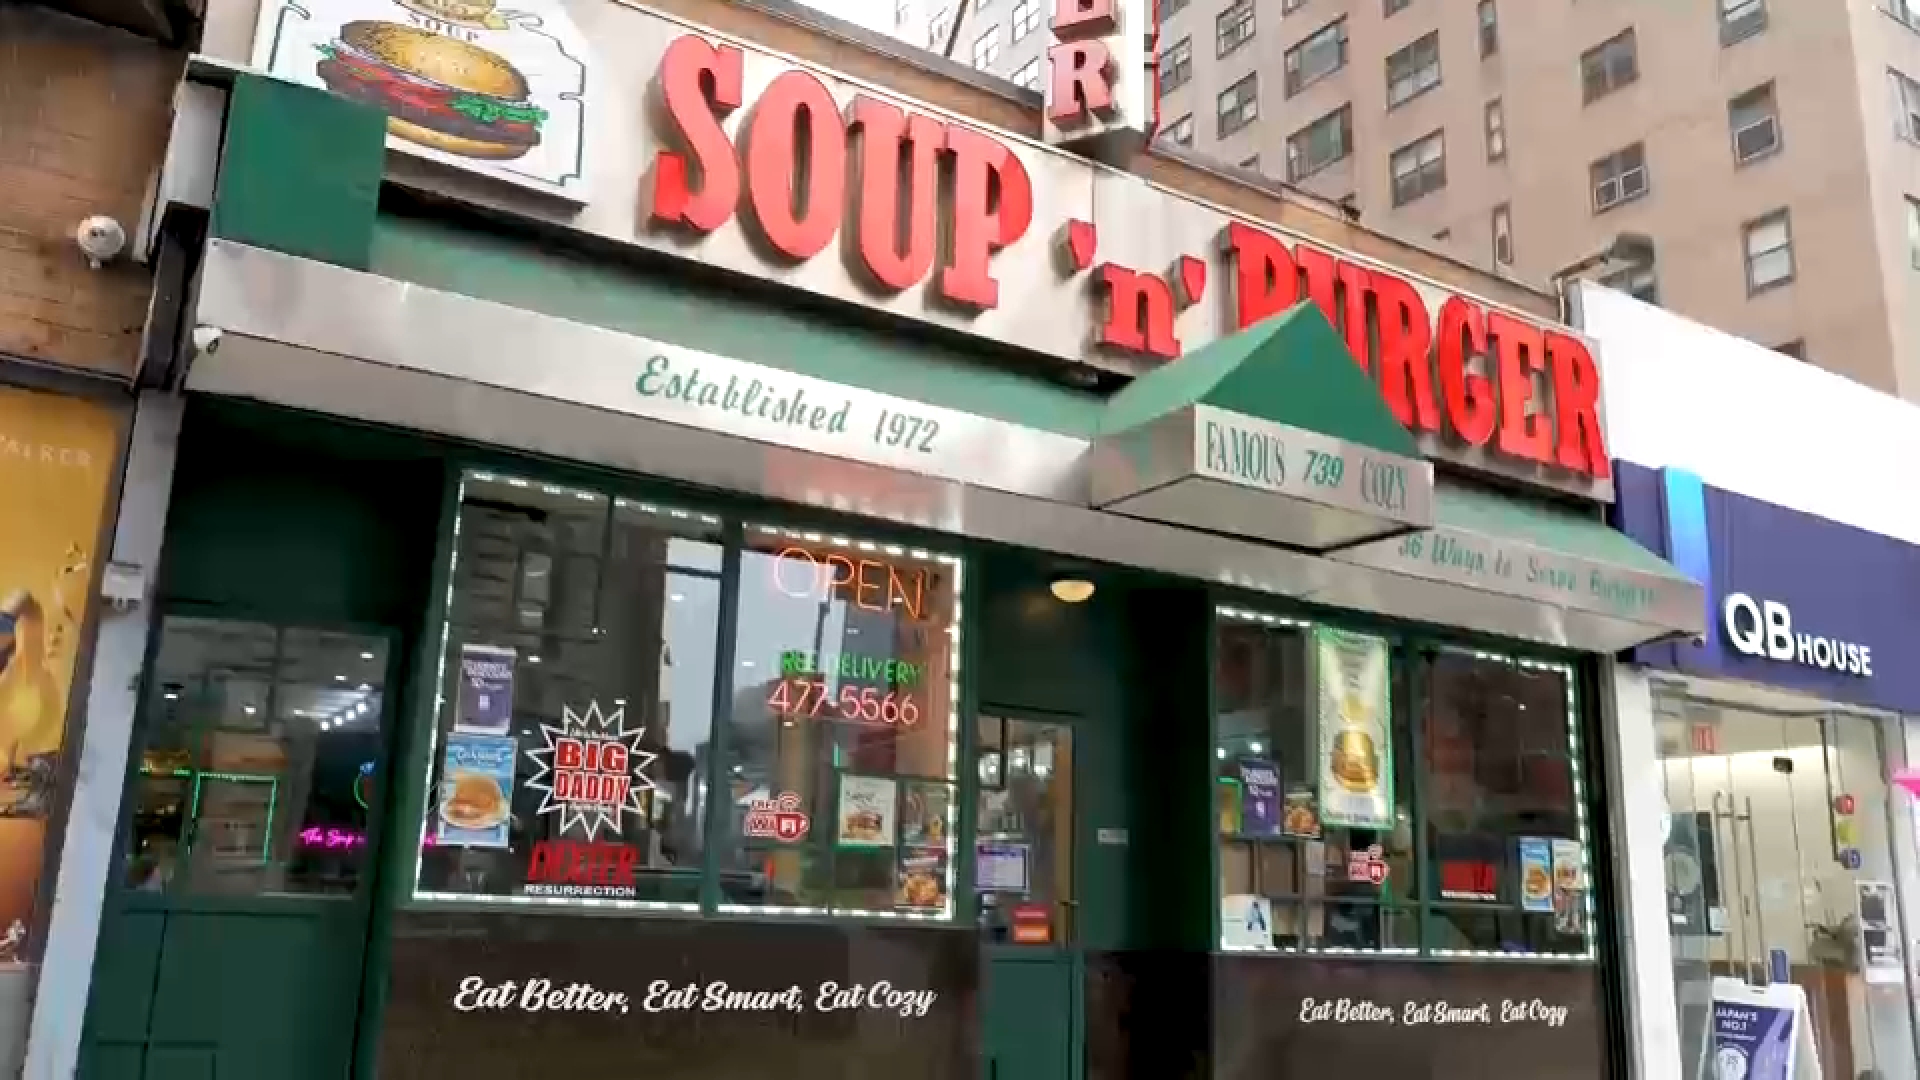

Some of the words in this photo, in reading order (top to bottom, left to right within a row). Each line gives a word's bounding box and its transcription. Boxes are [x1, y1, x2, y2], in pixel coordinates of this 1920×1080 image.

[655, 34, 1032, 309] SOUP
[635, 354, 853, 434] Established
[873, 409, 940, 453] 1972
[0, 435, 91, 467] ALKER
[1205, 420, 1286, 487] FAMOUS
[1303, 449, 1345, 488] 739
[1360, 456, 1408, 511] COZY
[773, 547, 925, 620] OPEN
[1725, 592, 1795, 660] QB
[1797, 632, 1873, 676] HOUSE
[767, 678, 920, 726] 477-5566
[555, 737, 630, 774] BIG
[554, 769, 632, 805] DADDY
[524, 883, 637, 898] RESURRECTION
[453, 975, 518, 1012] Eat
[519, 976, 630, 1017] Better,
[643, 979, 700, 1013] Eat
[702, 980, 804, 1013] Smart,
[815, 980, 866, 1012] Eat
[868, 979, 939, 1018] Cozy
[1301, 997, 1333, 1023] Eat
[1335, 997, 1395, 1025] Better,
[1403, 1001, 1432, 1025] Eat
[1434, 1001, 1491, 1024] Smart,
[1501, 998, 1527, 1023] Eat
[1529, 997, 1569, 1028] Cozy
